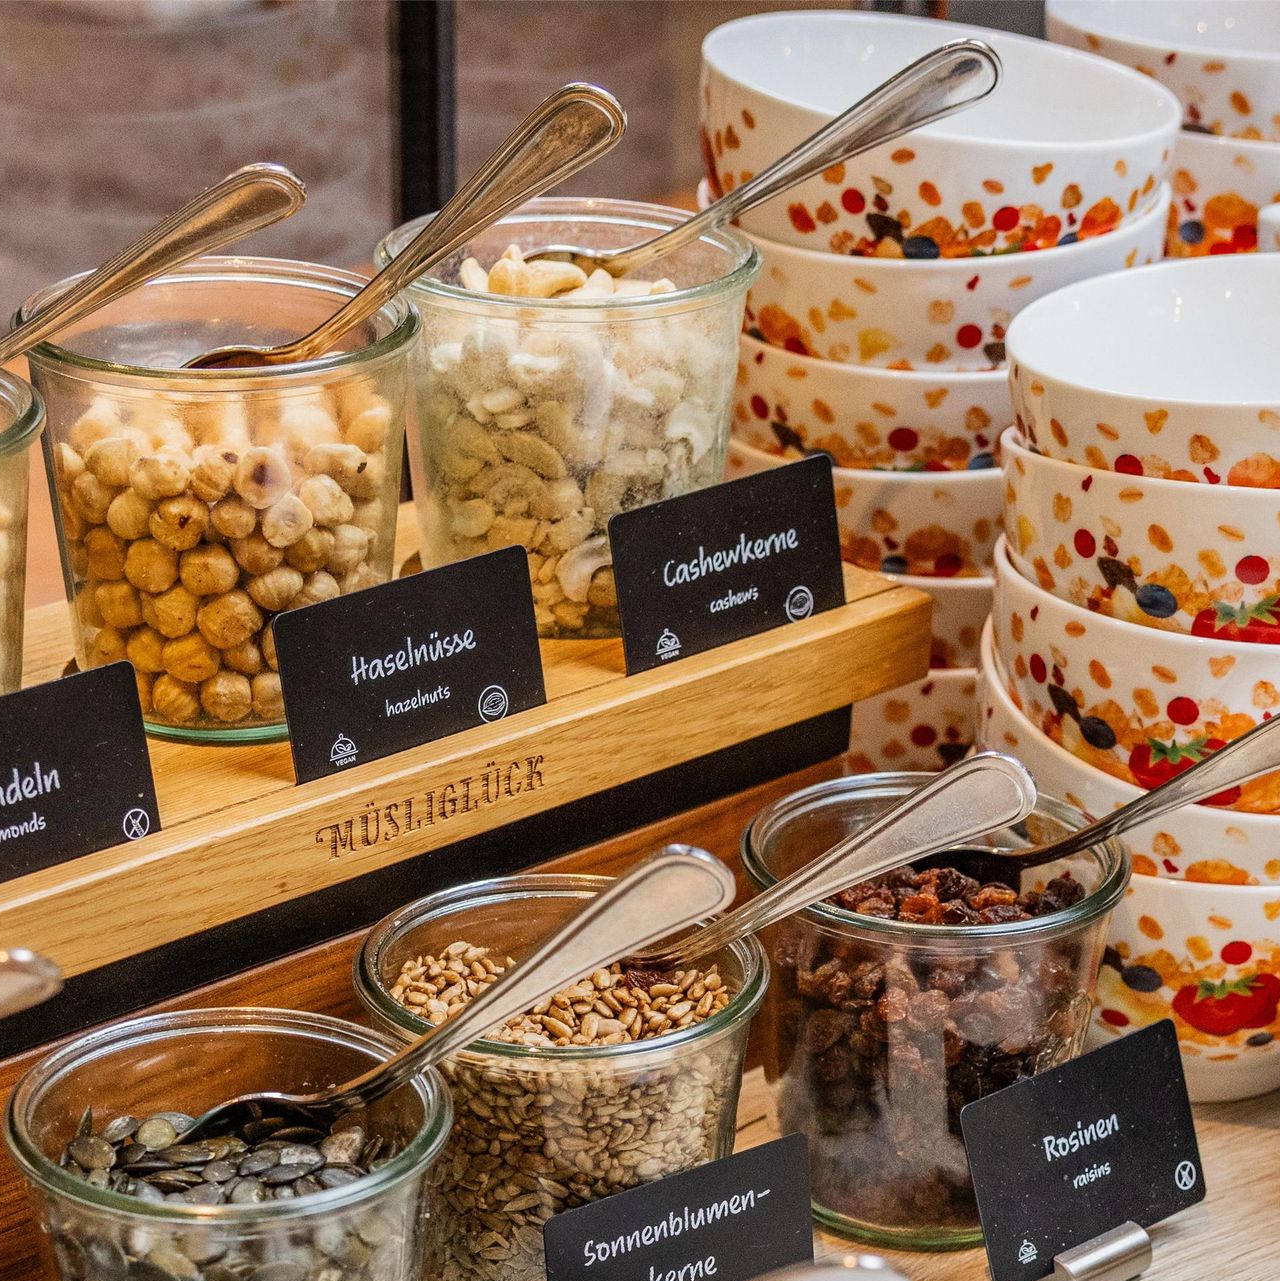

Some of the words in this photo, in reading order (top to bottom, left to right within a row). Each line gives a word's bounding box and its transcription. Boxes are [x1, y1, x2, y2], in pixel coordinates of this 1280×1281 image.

[662, 528, 799, 587] Cashewkerne
[709, 586, 759, 613] cashews
[351, 629, 476, 685] Haselnüsse
[386, 685, 451, 717] hazelnuts
[335, 755, 357, 767] VEGAN
[316, 754, 545, 860] MÜSLIGLÜCK
[1042, 1113, 1120, 1162] Rosinen
[1073, 1161, 1111, 1189] raisins
[583, 1186, 771, 1268] Sonnenblumen-
